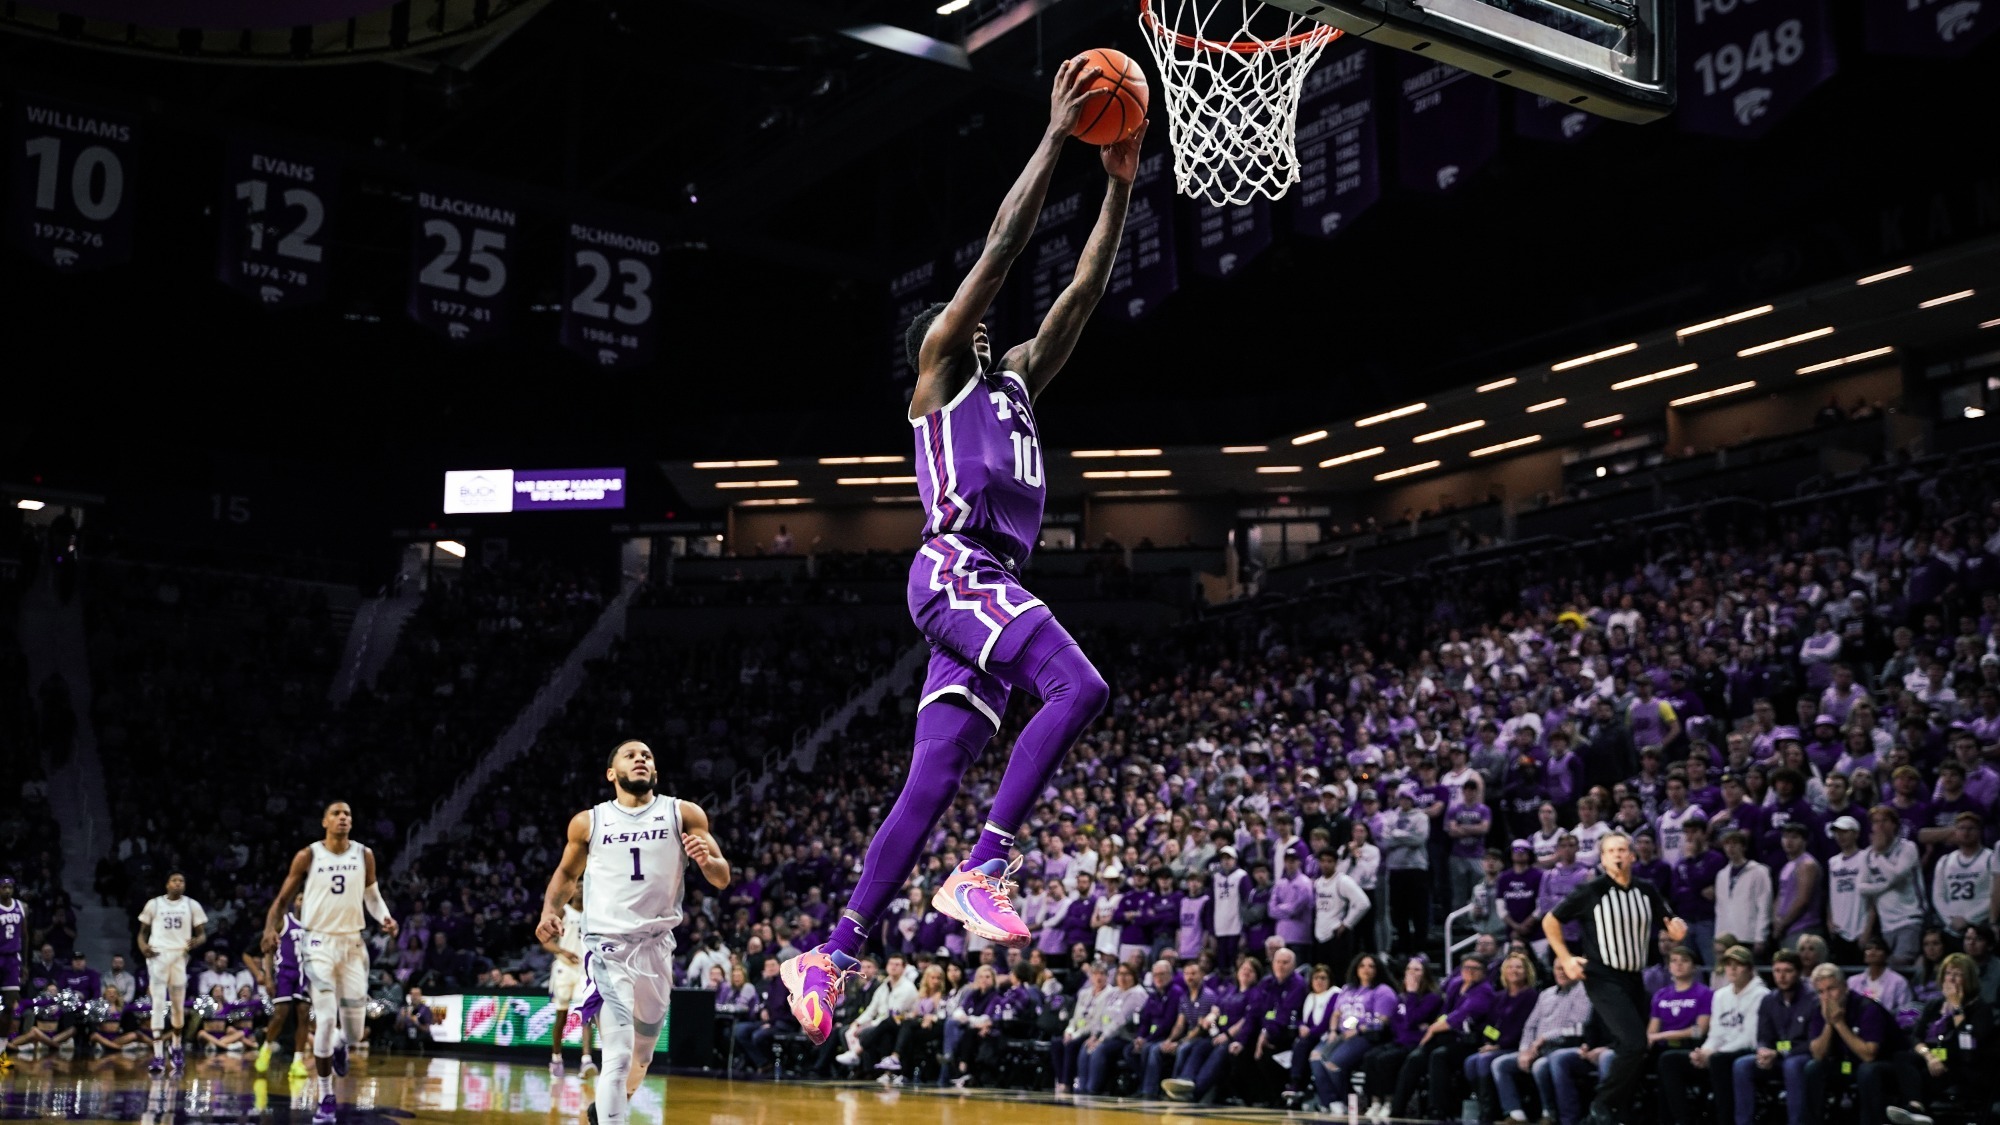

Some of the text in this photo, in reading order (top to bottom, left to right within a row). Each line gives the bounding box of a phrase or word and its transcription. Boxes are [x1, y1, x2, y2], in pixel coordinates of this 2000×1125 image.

[1694, 18, 1805, 96] 1948
[26, 104, 131, 142] WILLIAMS
[25, 136, 124, 222] 10
[251, 152, 316, 183] EVANS
[235, 179, 326, 263] 12
[418, 192, 517, 227] BLACKMAN
[32, 222, 103, 248] 1972-76
[570, 223, 661, 256] RICHMOND
[242, 260, 309, 287] 1974-78
[419, 218, 508, 298] 25
[571, 249, 653, 326] 23
[431, 299, 492, 323] 1977-81
[1010, 431, 1042, 488] 10
[571, 478, 622, 491] KANSAS
[210, 493, 252, 524] 15
[602, 828, 669, 845] K-STATE
[318, 865, 358, 873] K-STATE
[629, 848, 645, 881] 1
[331, 875, 345, 894] 3
[1950, 881, 1975, 900] 23
[5, 924, 15, 939] 2
[164, 917, 182, 929] 35
